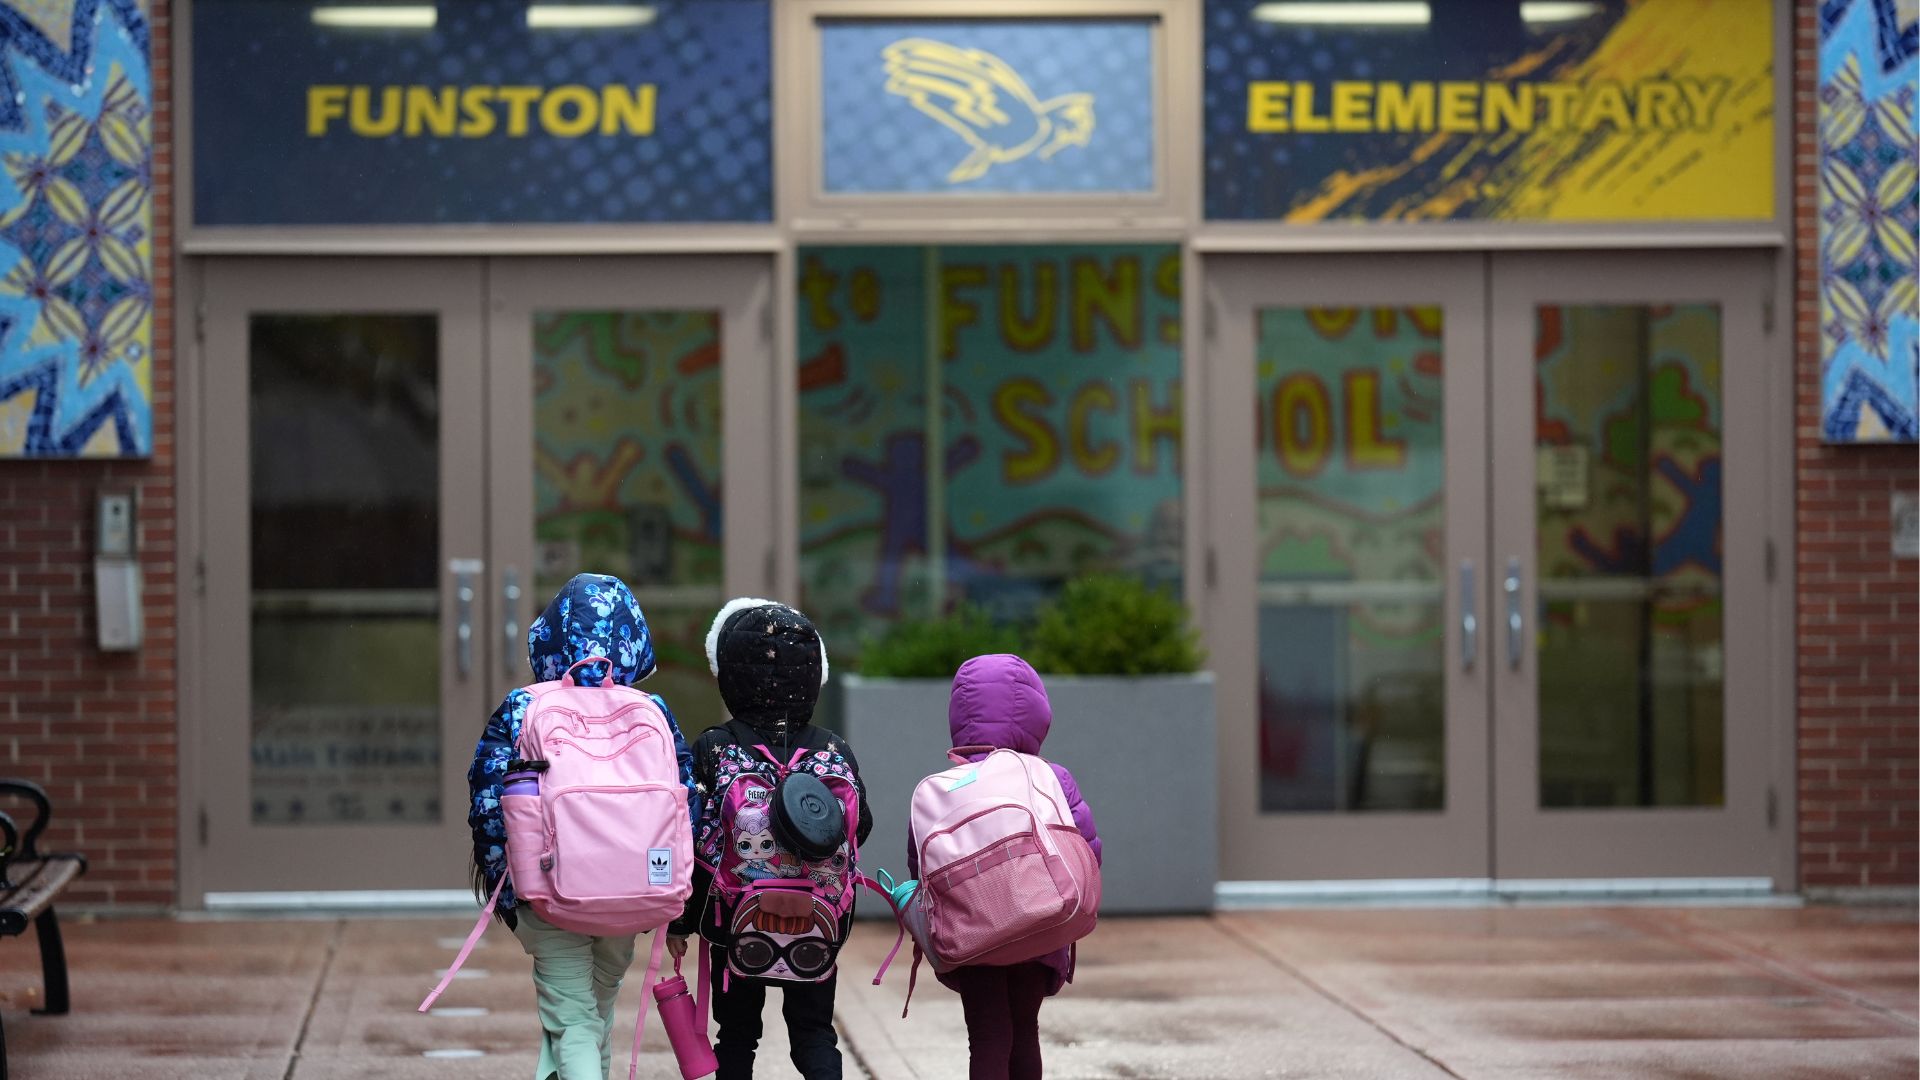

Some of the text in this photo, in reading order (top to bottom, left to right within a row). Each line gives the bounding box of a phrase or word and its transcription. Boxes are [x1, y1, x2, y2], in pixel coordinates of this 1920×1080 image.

[306, 84, 657, 137] FUNSTON
[1247, 78, 1730, 133] ELEMENTARY
[800, 256, 882, 332] to
[991, 375, 1407, 486] SCHOL
